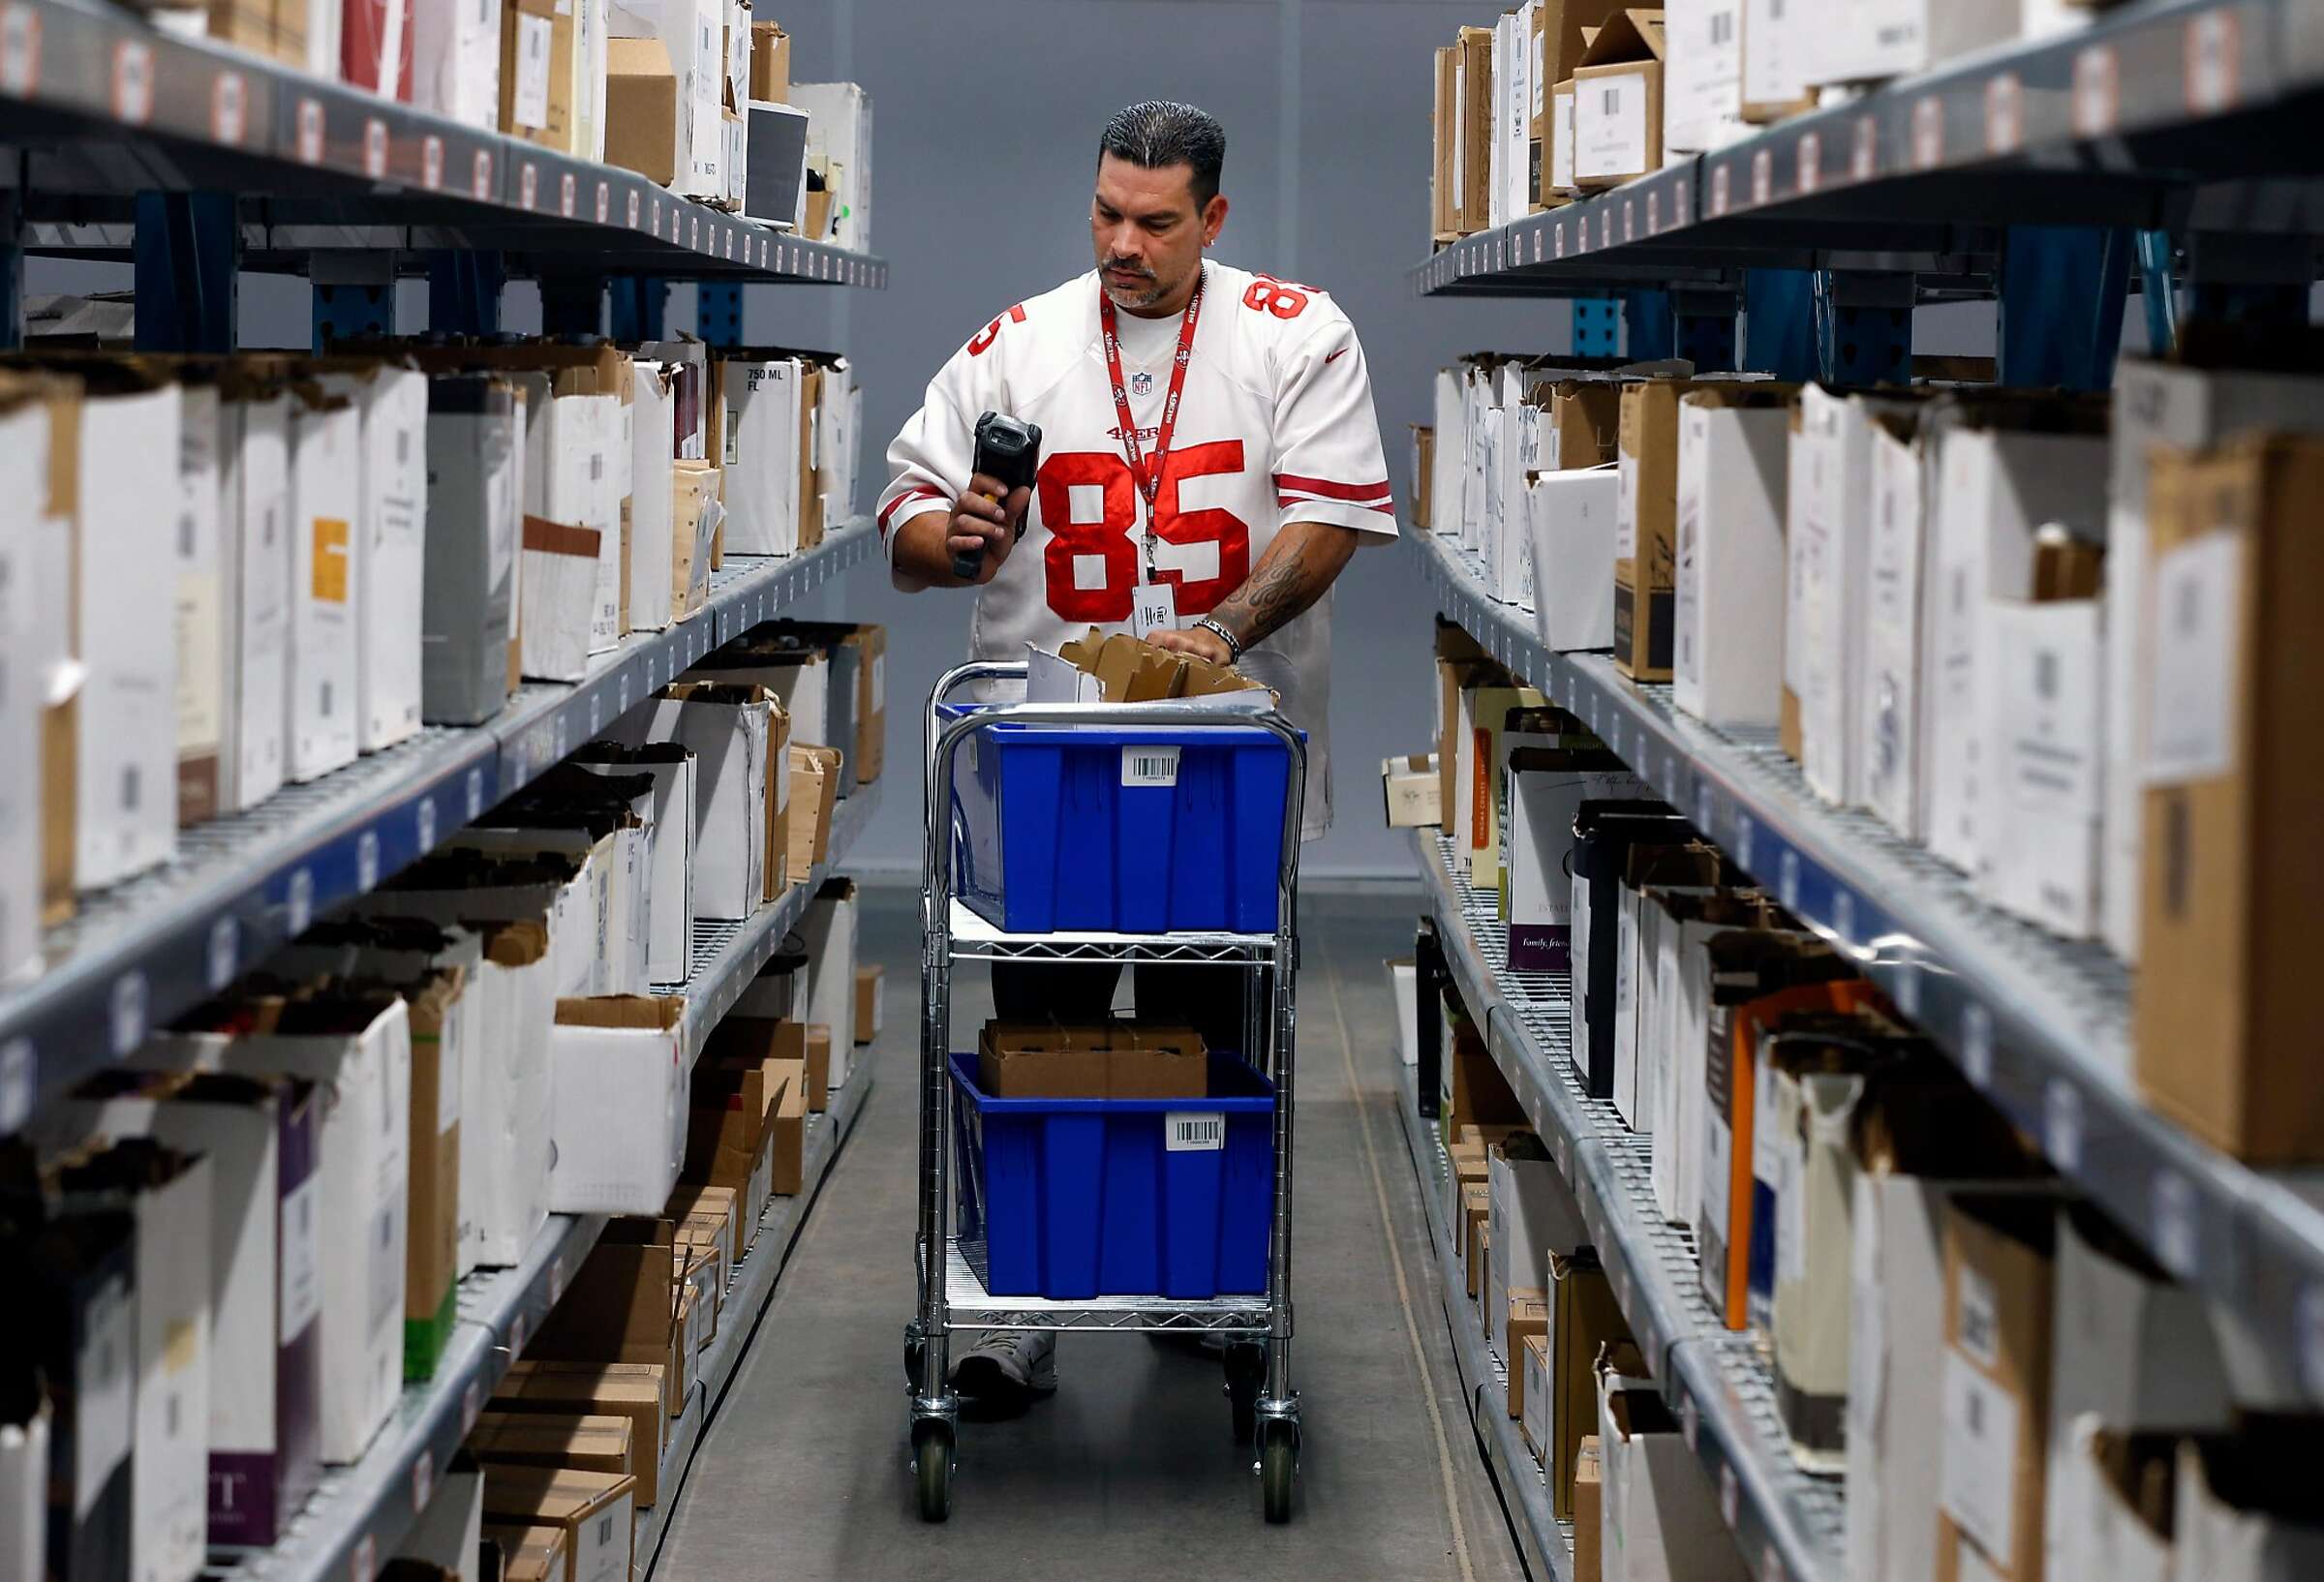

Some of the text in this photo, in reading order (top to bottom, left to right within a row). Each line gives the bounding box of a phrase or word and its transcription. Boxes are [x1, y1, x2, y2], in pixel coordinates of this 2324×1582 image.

[748, 368, 783, 380] 750 ML
[748, 380, 760, 391] FL
[1133, 381, 1152, 394] NFL
[1106, 426, 1175, 441] 4ER
[1037, 439, 1249, 622] 85
